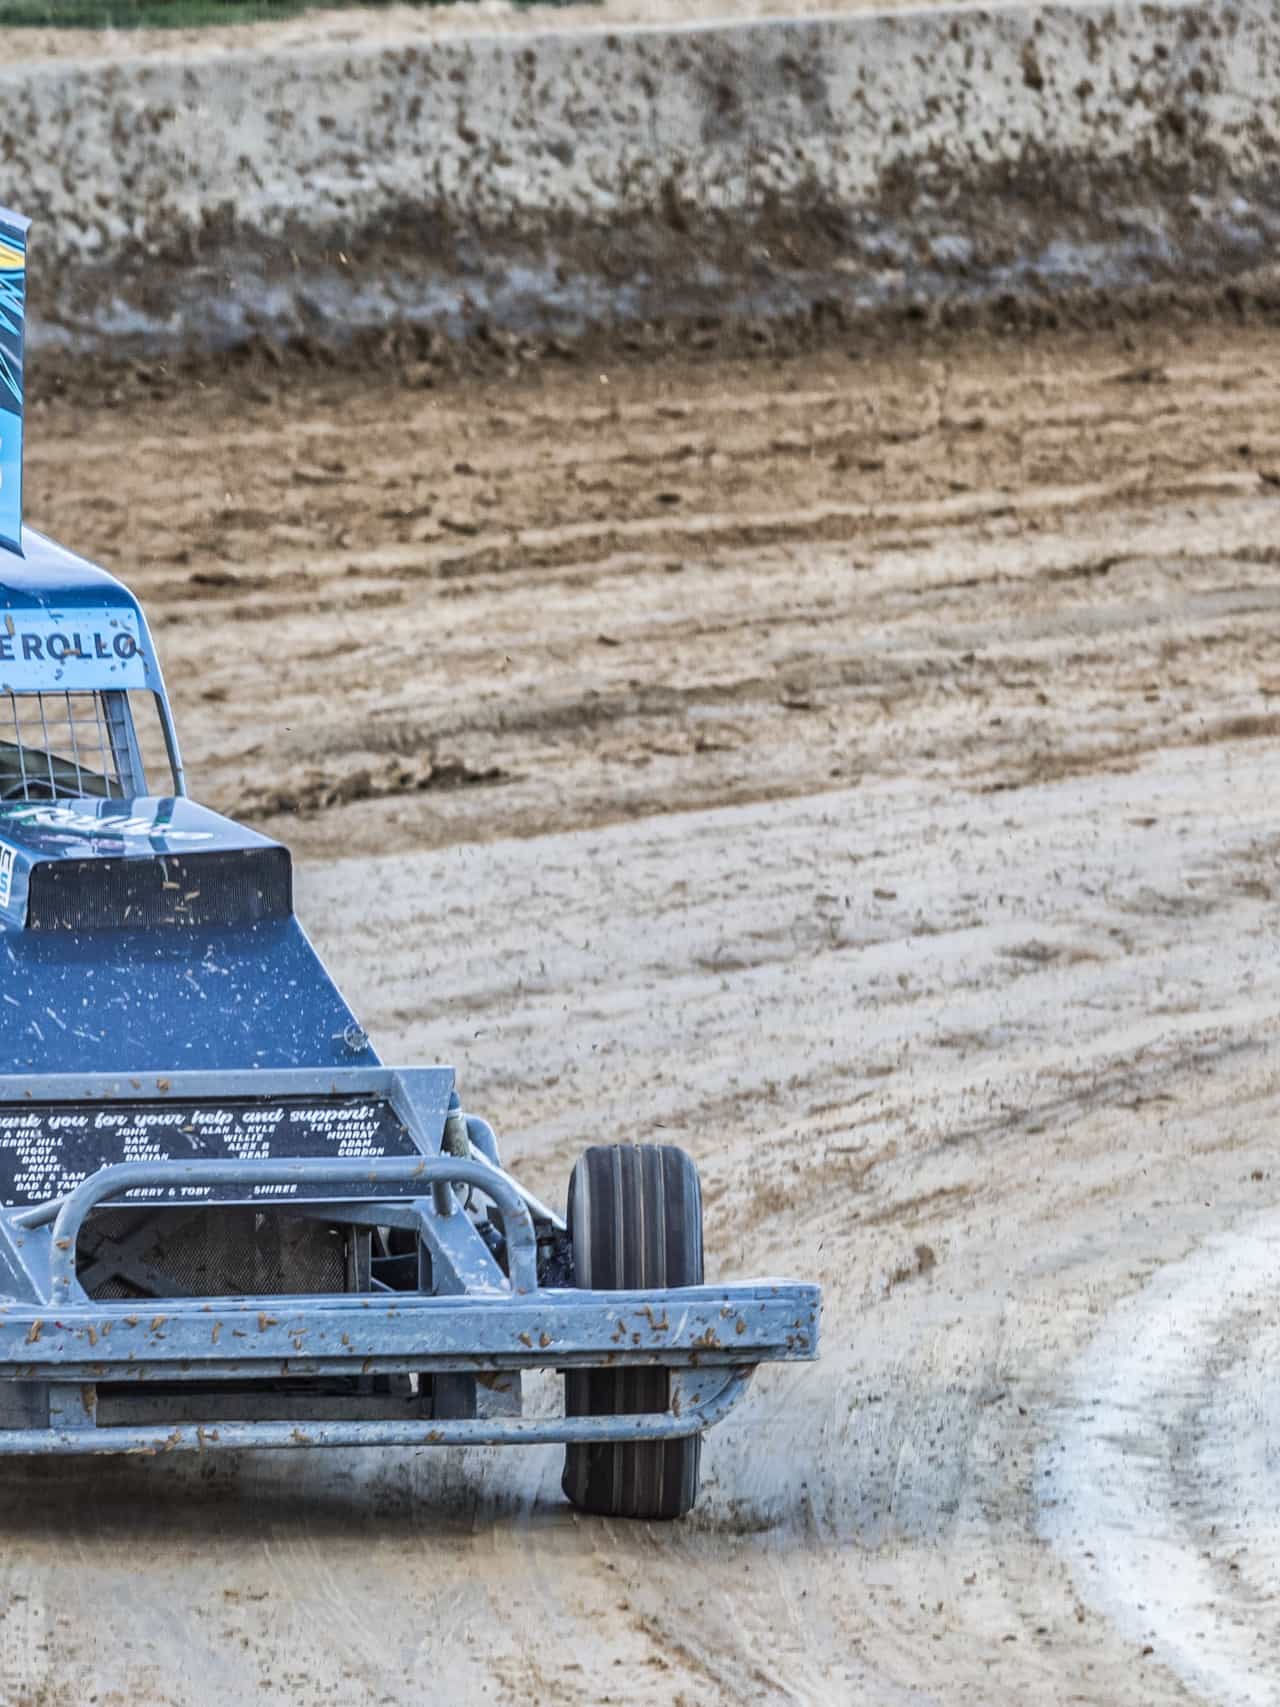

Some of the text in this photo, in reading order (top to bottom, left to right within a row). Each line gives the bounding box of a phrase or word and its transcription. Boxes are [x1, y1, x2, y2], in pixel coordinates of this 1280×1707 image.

[21, 632, 137, 661] ROLLO
[47, 1117, 89, 1130] you
[94, 1112, 129, 1128] for
[134, 1115, 186, 1129] your
[191, 1109, 234, 1125] help
[241, 1108, 284, 1122] and
[289, 1105, 375, 1123] support:
[115, 1127, 148, 1136] JOHN
[200, 1125, 230, 1134] ALAN
[247, 1123, 277, 1133] KYLE
[310, 1123, 333, 1132] TED
[16, 1129, 44, 1139] HILL
[223, 1133, 264, 1143] WILLIE
[326, 1130, 375, 1140] MURRAY
[36, 1137, 64, 1146] HILL
[124, 1136, 150, 1145] SAM
[340, 1139, 371, 1148] ADAM
[16, 1146, 54, 1156] HIGGY
[123, 1144, 161, 1154] KAYNE
[227, 1142, 257, 1152] ALEX
[338, 1146, 385, 1157] GORDON
[21, 1155, 58, 1165] DAVID
[28, 1164, 62, 1173] MARK
[13, 1173, 43, 1183] RYAN
[62, 1171, 87, 1181] SAM
[57, 1180, 81, 1190] TAR
[254, 1184, 298, 1195] SHIREE
[181, 1186, 211, 1196] TOBY
